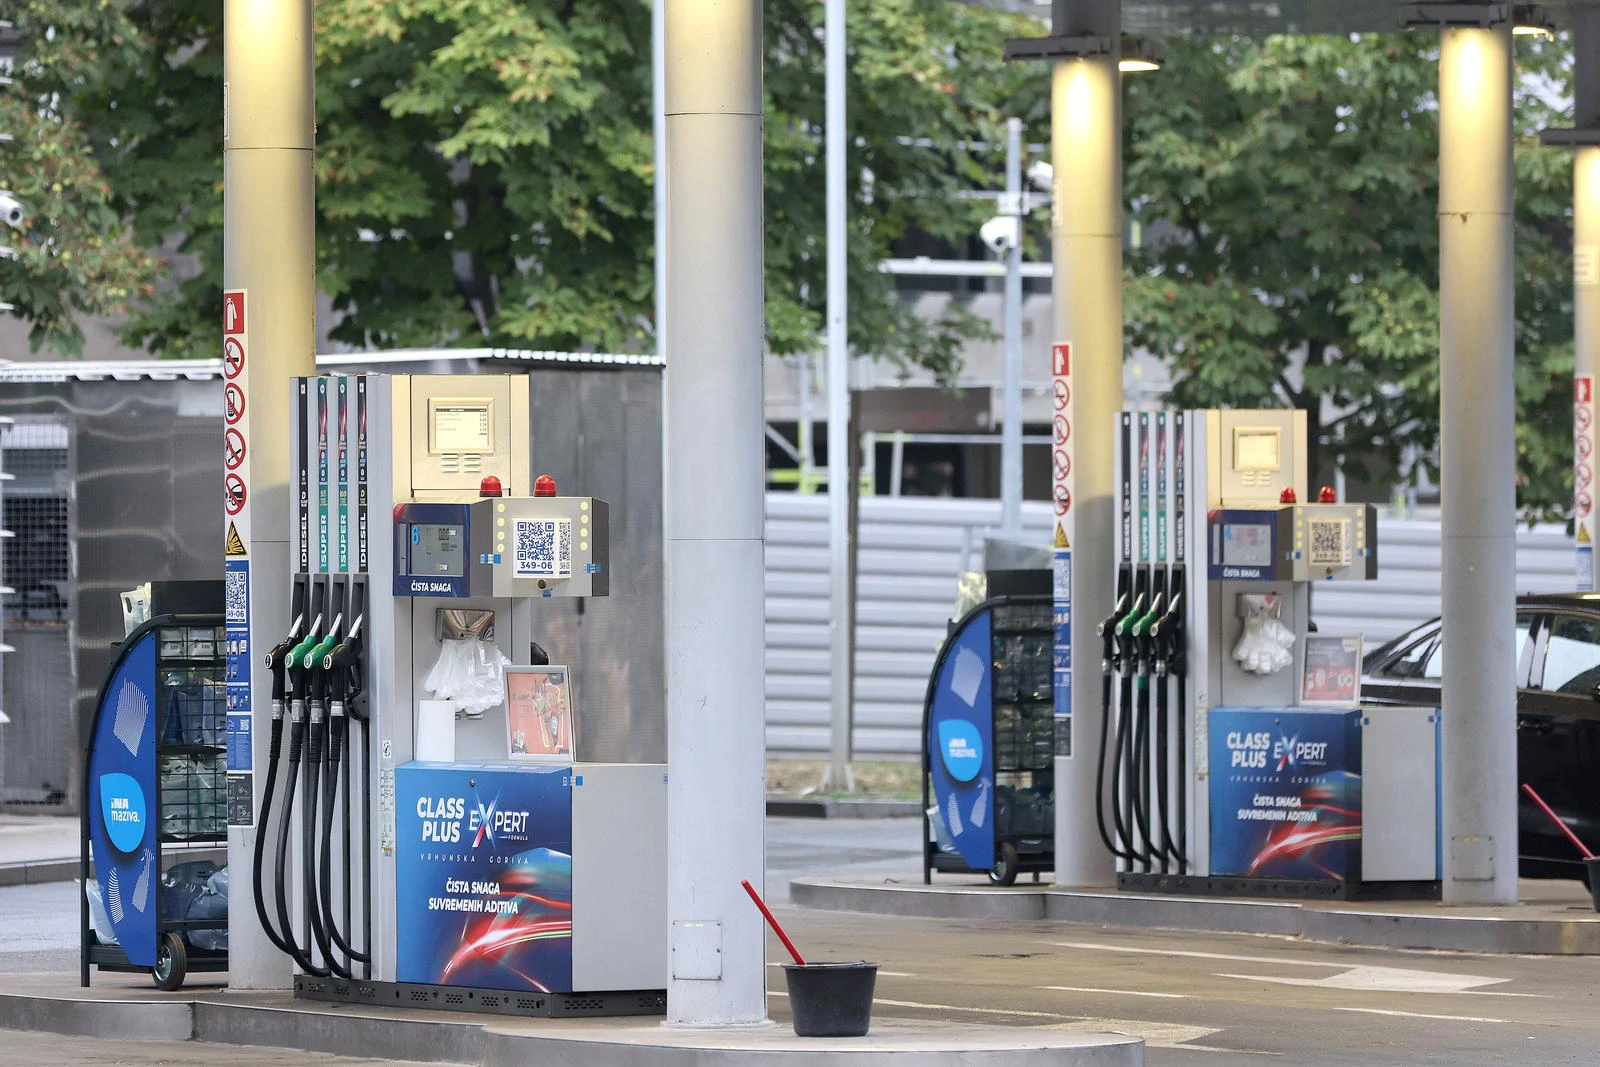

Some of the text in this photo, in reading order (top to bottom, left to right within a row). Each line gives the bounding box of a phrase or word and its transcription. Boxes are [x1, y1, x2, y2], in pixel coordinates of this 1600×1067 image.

[520, 561, 552, 569] 349-06
[411, 580, 451, 592] ČISTA SNAGA
[1227, 732, 1271, 750] CLASS
[1232, 750, 1267, 768] PLUS
[1274, 735, 1327, 772] EXPERT
[417, 797, 464, 819] CLASS
[1253, 793, 1301, 808] ČISTA SNAGA
[111, 810, 140, 823] maziva.
[469, 800, 529, 848] EXPERT
[1237, 809, 1317, 822] SUVREMENIH ADITIVA
[422, 821, 460, 843] PLUS
[420, 853, 529, 864] VRHUNSKA GORIVA
[446, 877, 500, 895] ČISTA SNAGA
[428, 898, 518, 914] SUVREMENIH ADITIVA
